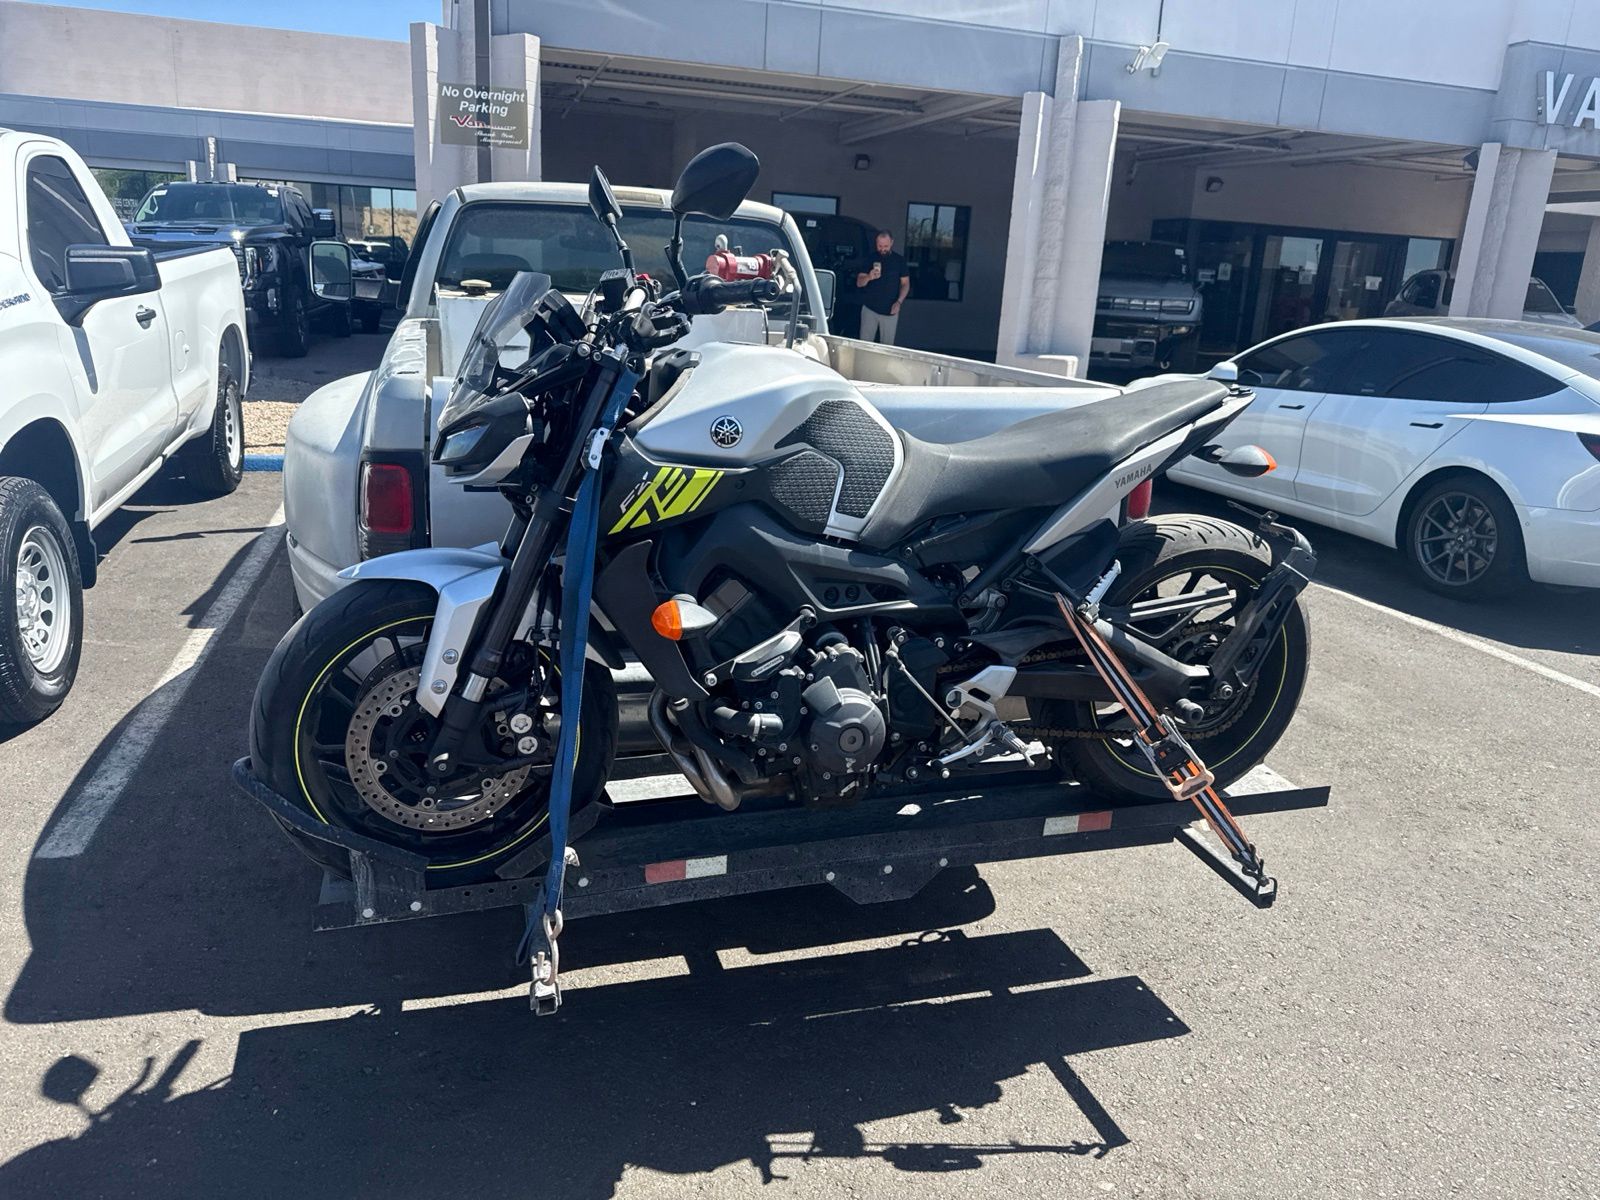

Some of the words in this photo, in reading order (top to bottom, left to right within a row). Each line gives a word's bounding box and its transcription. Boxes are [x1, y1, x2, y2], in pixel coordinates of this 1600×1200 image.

[441, 85, 460, 97] No
[463, 87, 525, 104] Overnight
[1546, 71, 1600, 129] VA
[459, 101, 509, 117] Parking
[1115, 463, 1152, 488] YAMAHA
